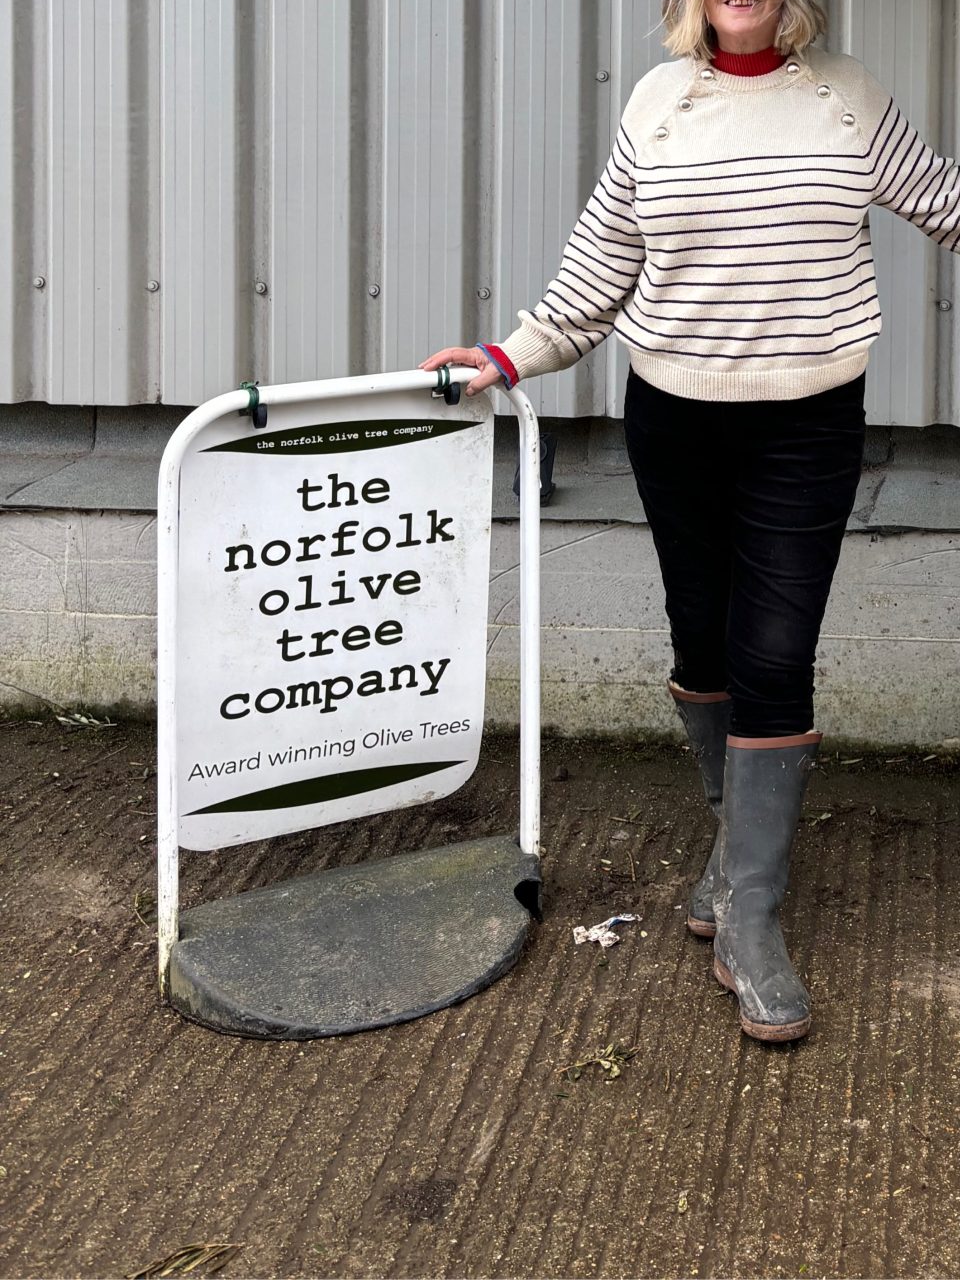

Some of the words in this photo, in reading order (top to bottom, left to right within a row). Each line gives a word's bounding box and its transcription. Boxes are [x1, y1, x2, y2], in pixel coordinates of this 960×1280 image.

[256, 440, 275, 449] the
[280, 436, 323, 448] norfolk
[328, 432, 359, 442] olive
[364, 430, 388, 439] tree
[393, 424, 434, 436] company
[296, 473, 390, 512] the
[224, 509, 455, 573] norfolk
[258, 569, 421, 616] olive
[277, 619, 403, 662] tree
[219, 658, 451, 720] company
[187, 751, 261, 782] Award
[268, 738, 356, 768] winning
[362, 728, 413, 749] Olive
[419, 719, 470, 739] Trees
